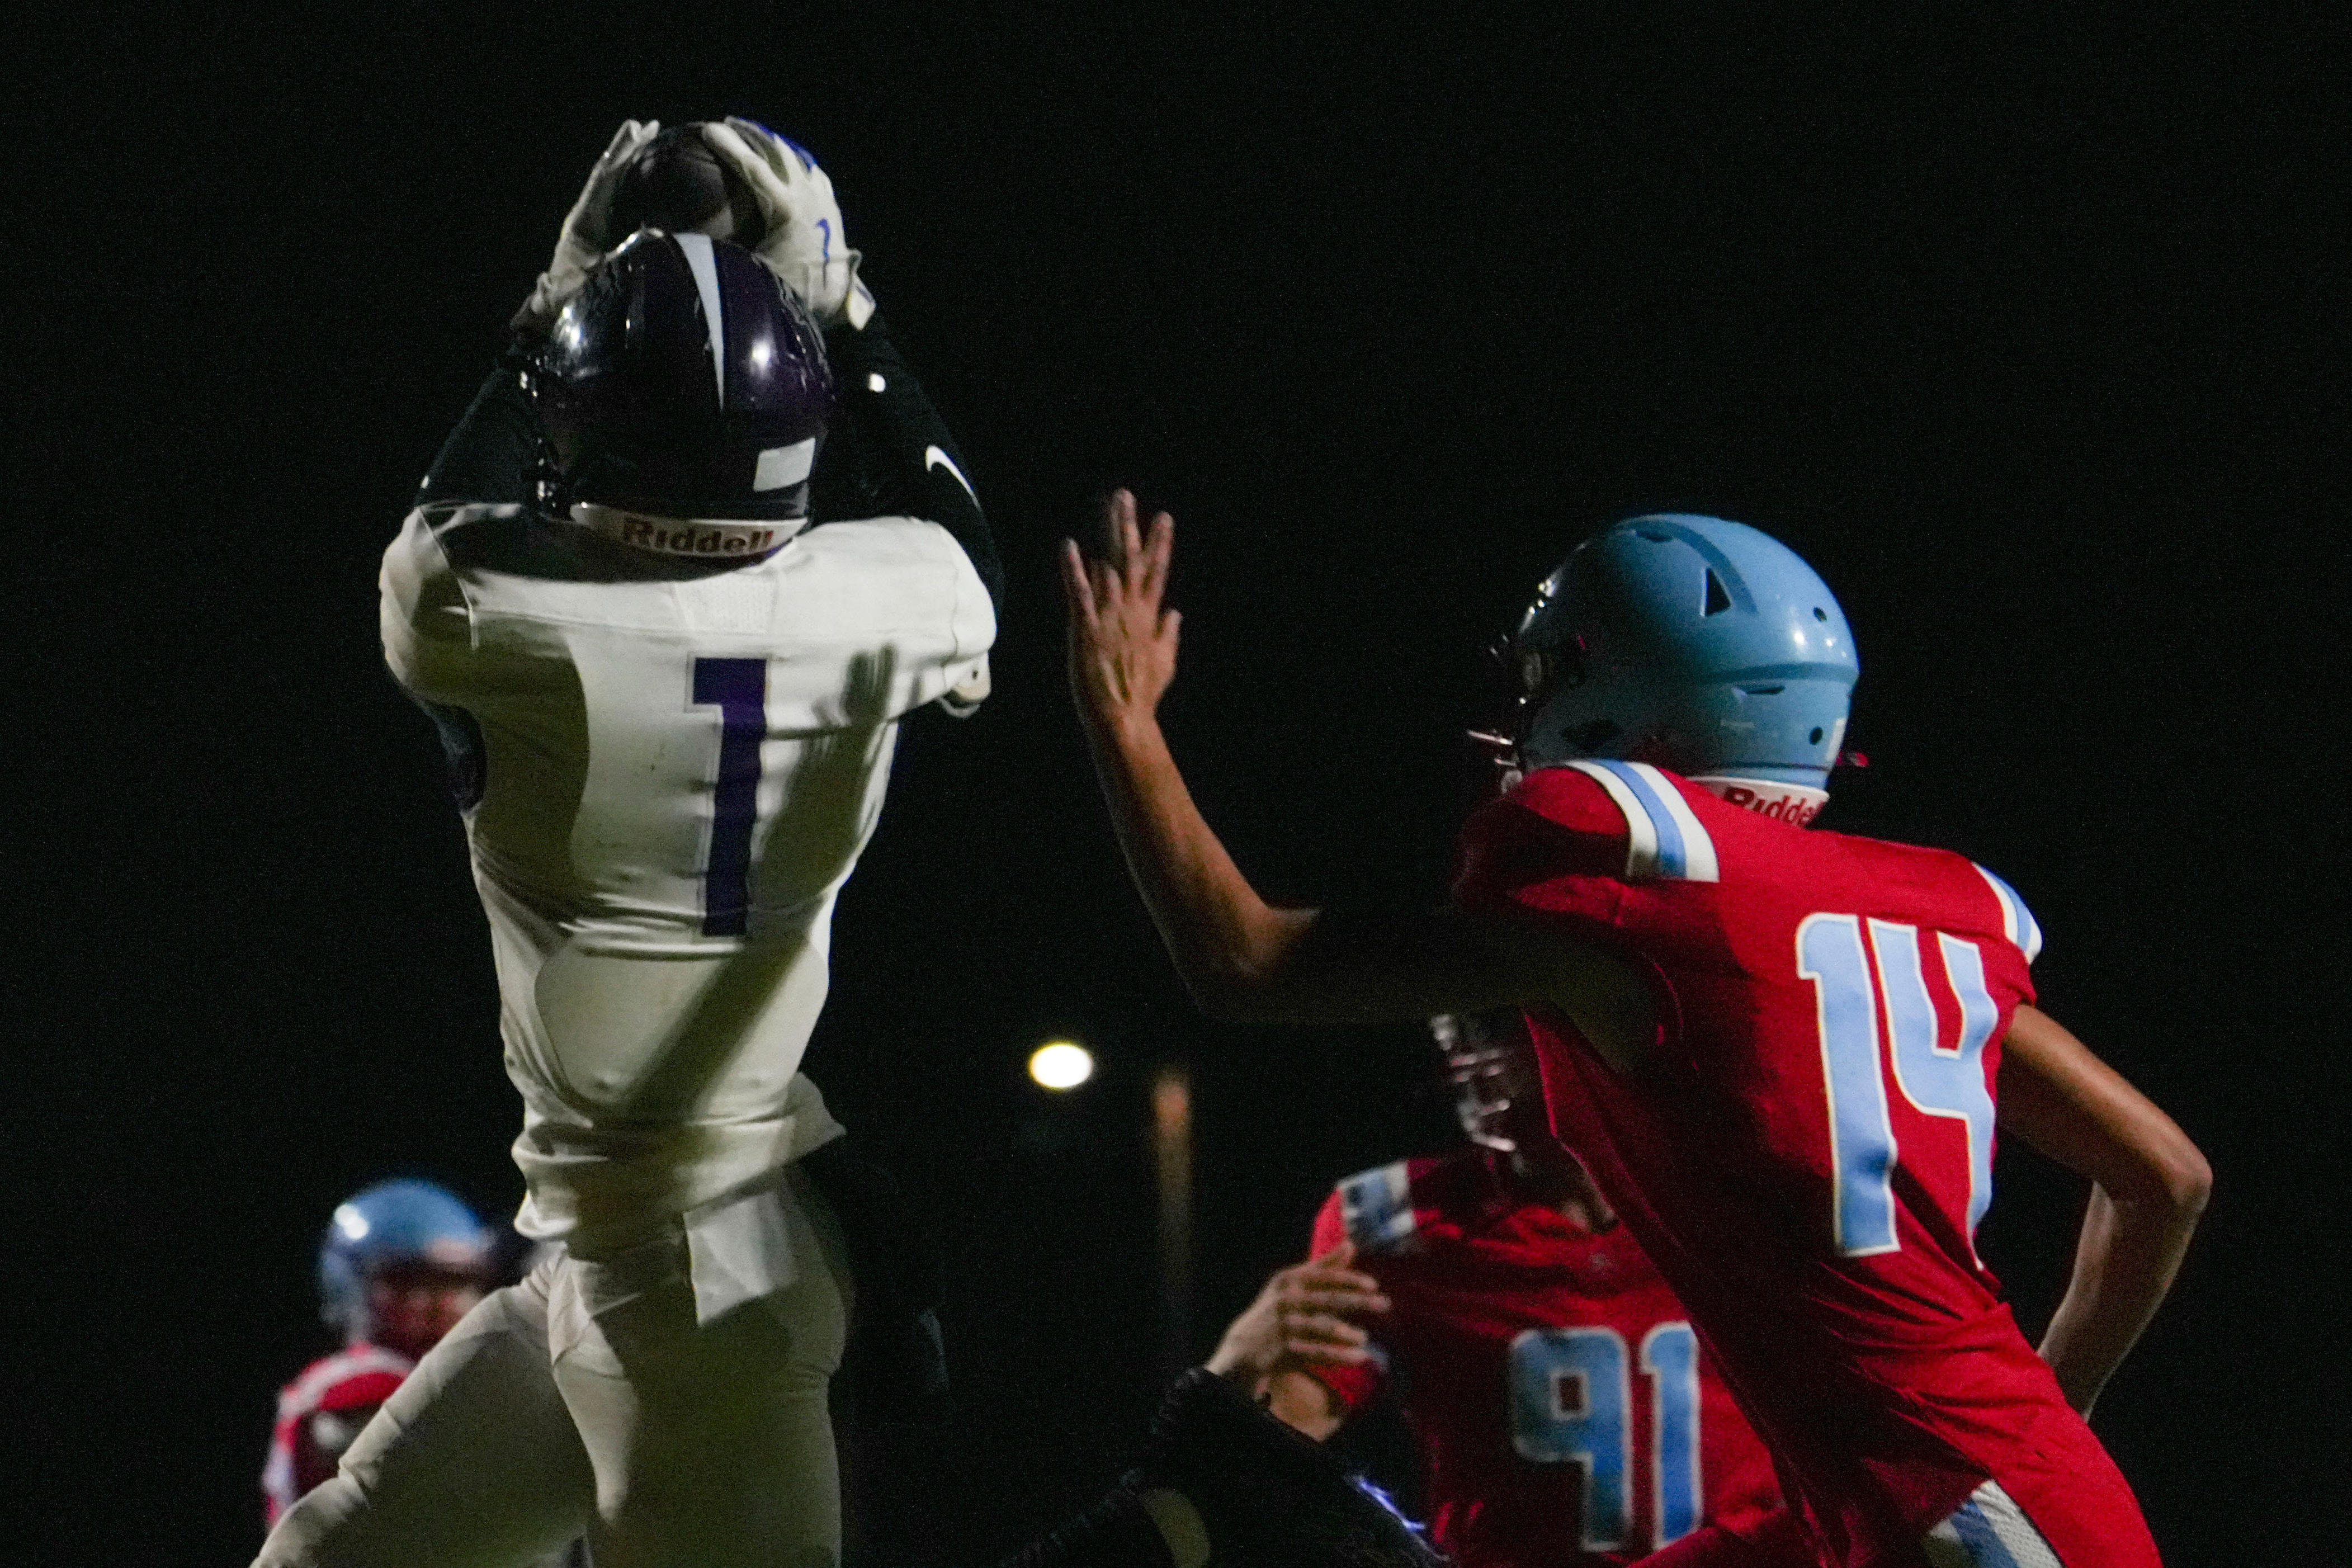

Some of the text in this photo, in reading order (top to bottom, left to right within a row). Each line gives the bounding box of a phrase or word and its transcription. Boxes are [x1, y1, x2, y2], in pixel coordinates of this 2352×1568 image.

[623, 516, 774, 553] Riddell
[690, 657, 767, 938] 1
[1794, 911, 1999, 1272] 14
[1508, 1319, 1704, 1552] 91
